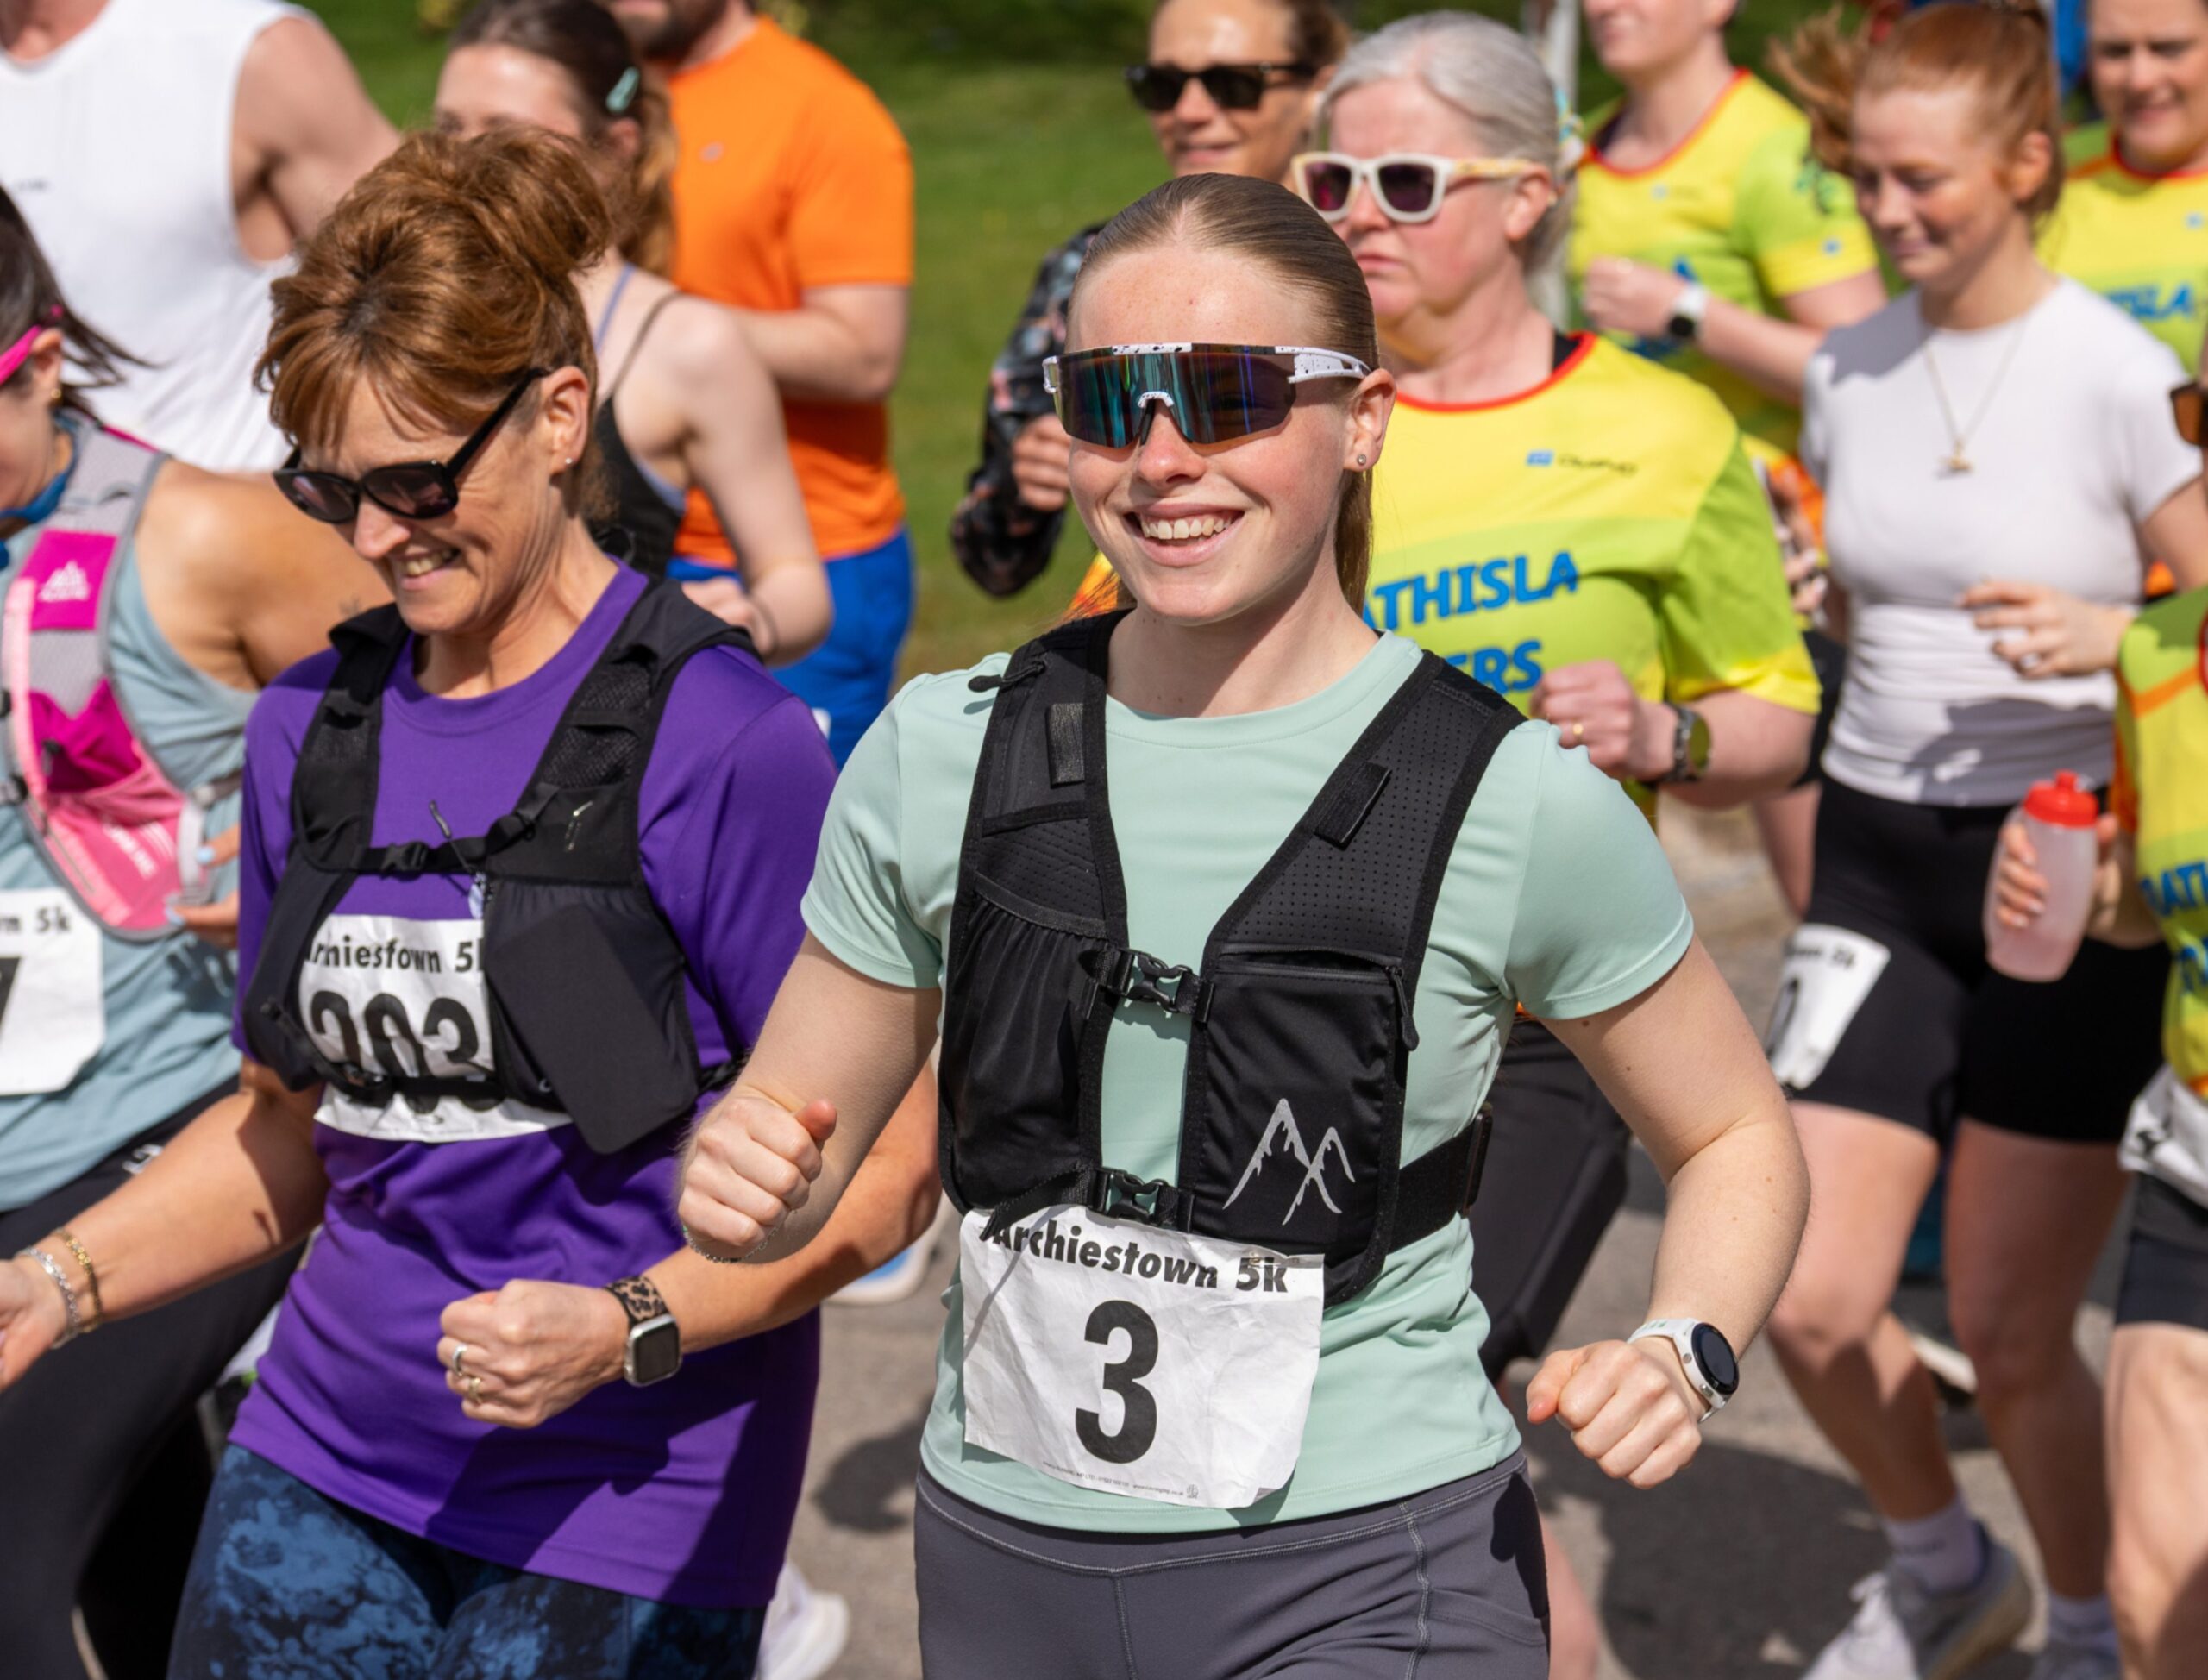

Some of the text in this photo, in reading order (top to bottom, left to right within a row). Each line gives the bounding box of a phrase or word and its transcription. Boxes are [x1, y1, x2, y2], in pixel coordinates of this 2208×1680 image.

[35, 906, 72, 934] 5k
[1235, 1257, 1289, 1293] 5k
[1075, 1300, 1159, 1464] 3
